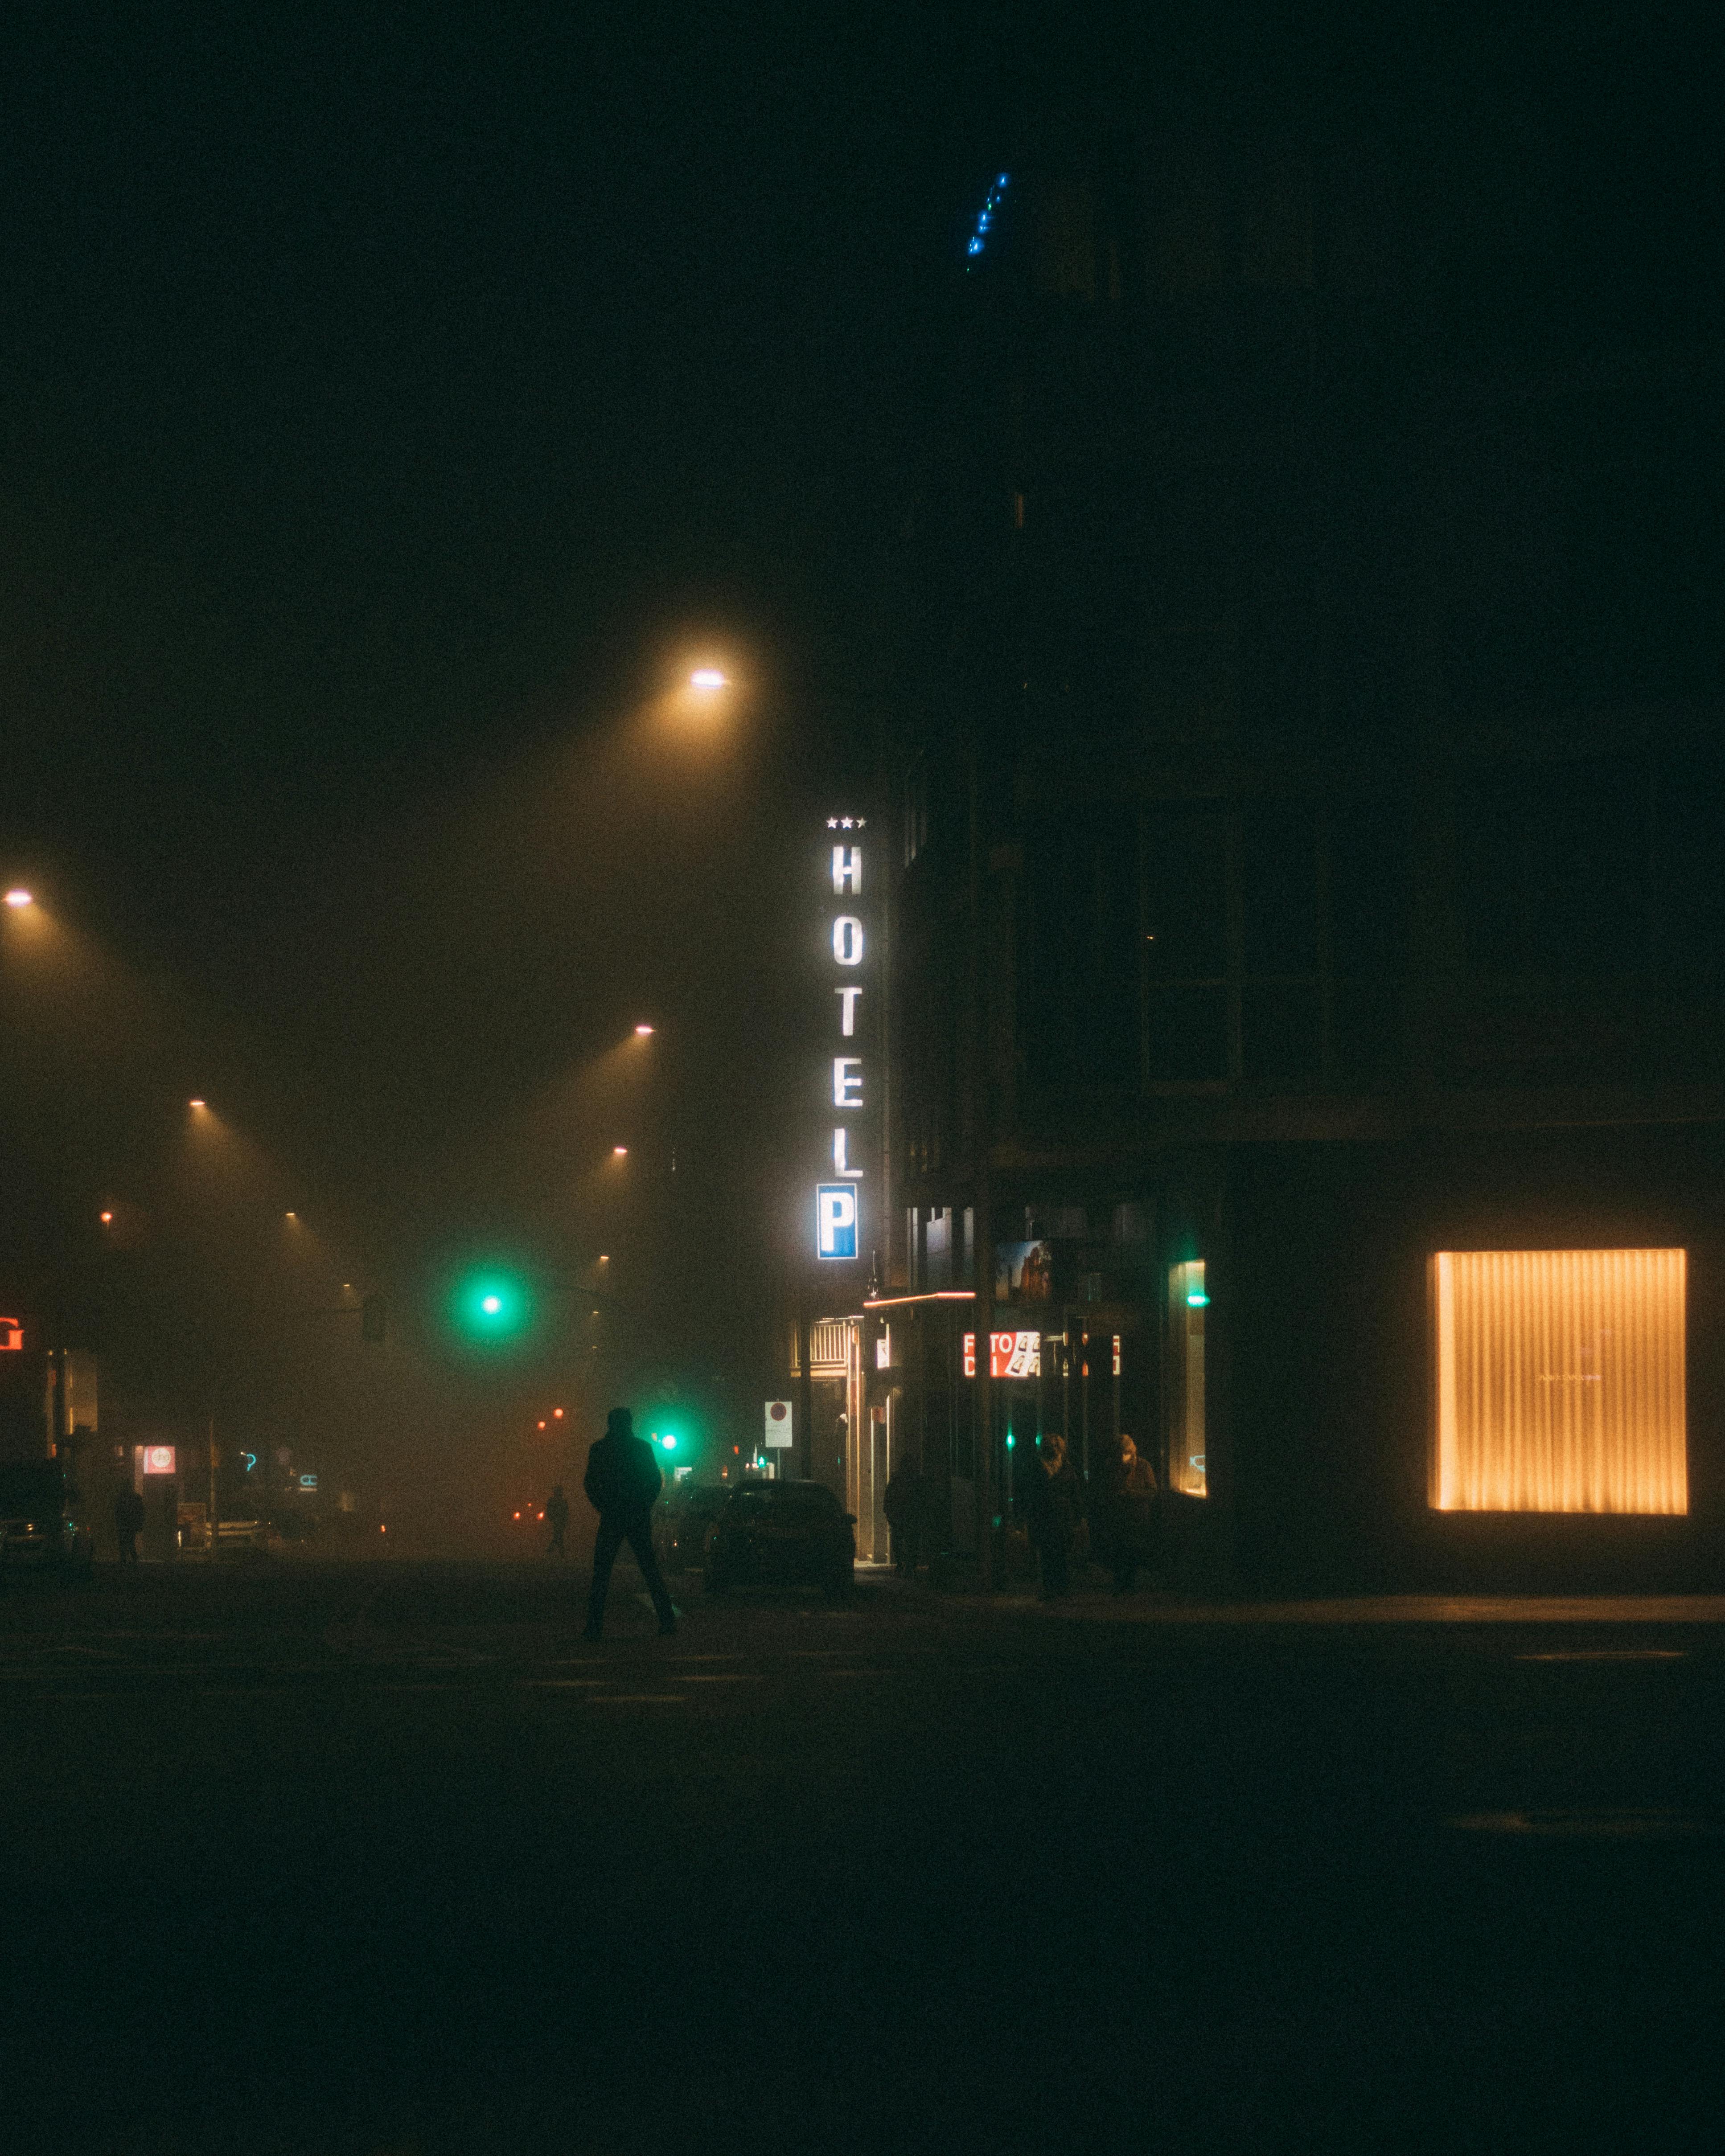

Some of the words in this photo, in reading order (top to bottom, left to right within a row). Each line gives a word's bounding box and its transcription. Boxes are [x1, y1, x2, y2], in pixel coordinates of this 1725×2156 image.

[832, 846, 863, 1177] HOTEL
[820, 1192, 854, 1251] P
[964, 1334, 1013, 1353] FTO
